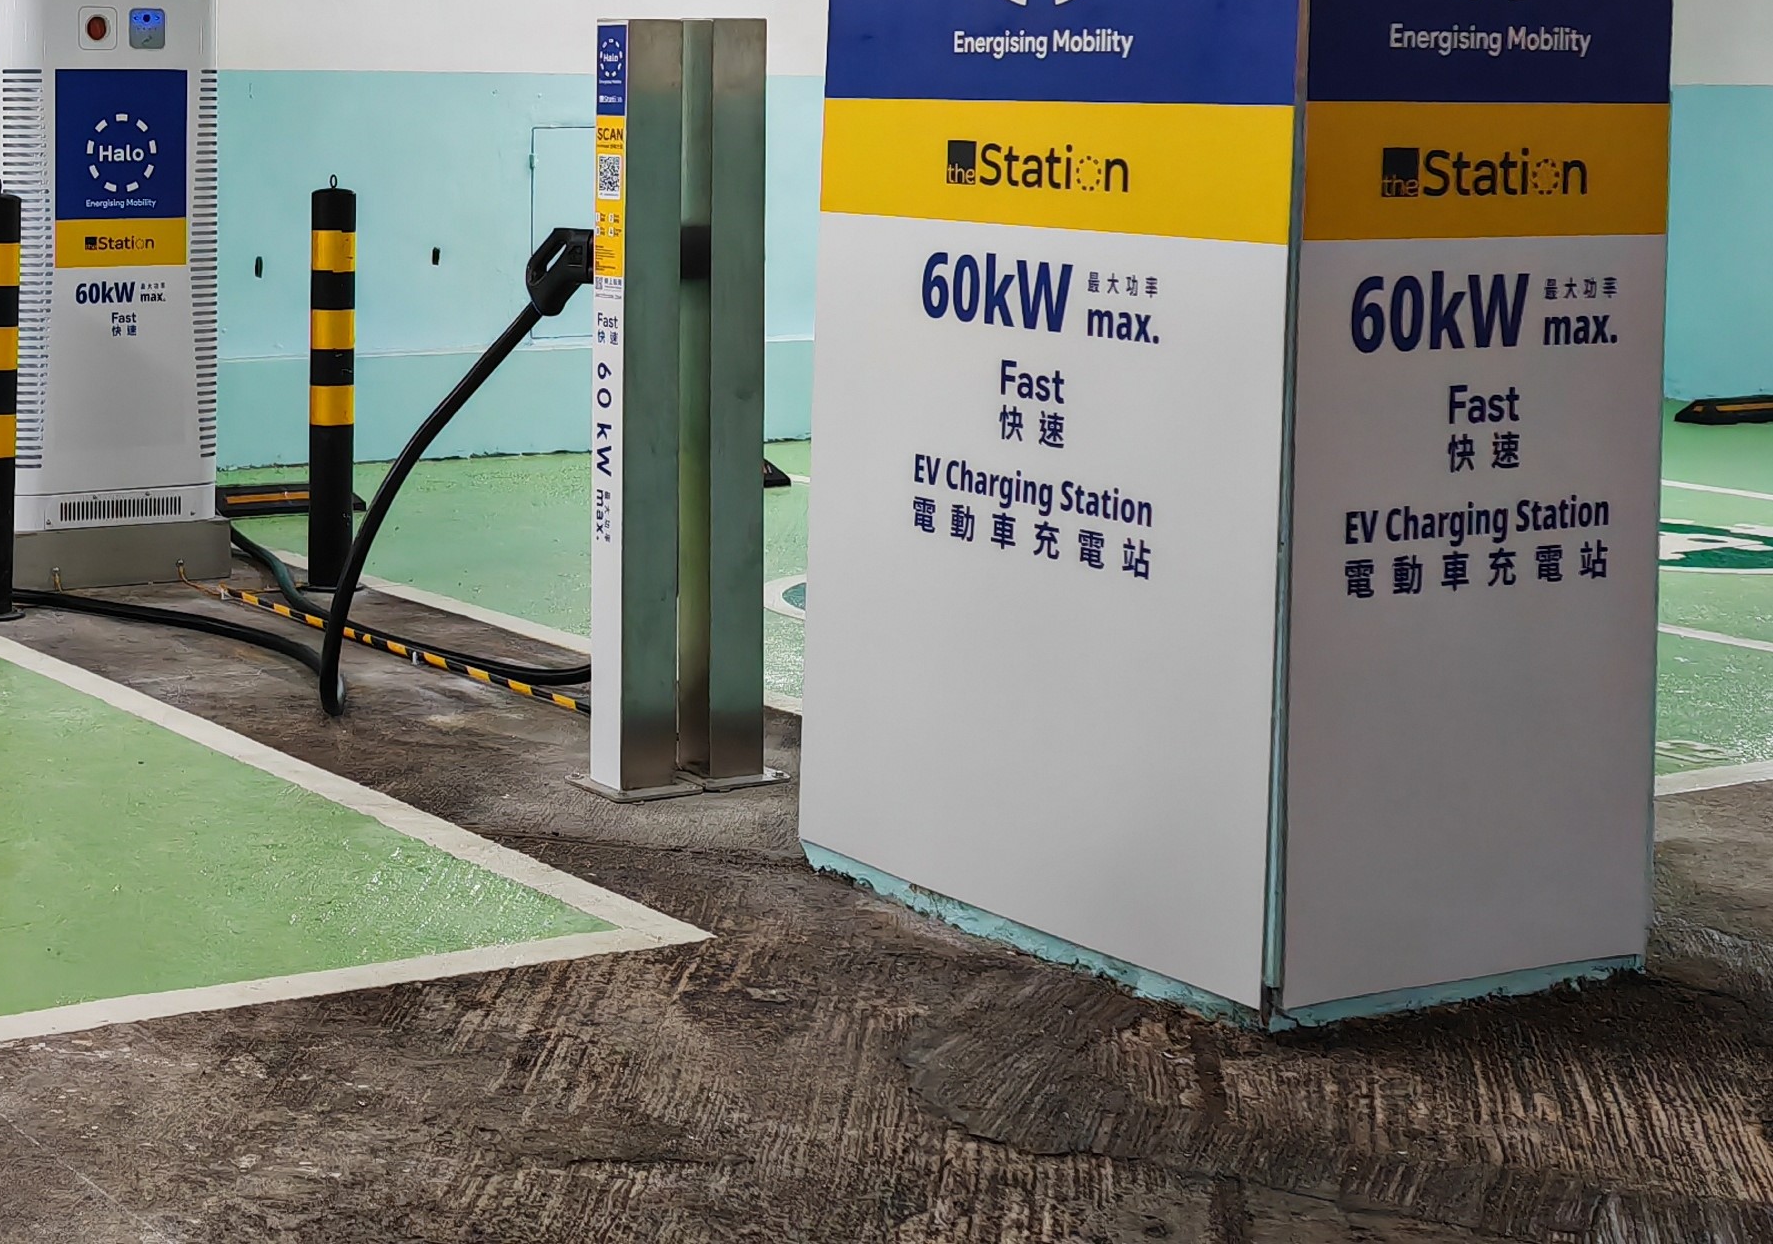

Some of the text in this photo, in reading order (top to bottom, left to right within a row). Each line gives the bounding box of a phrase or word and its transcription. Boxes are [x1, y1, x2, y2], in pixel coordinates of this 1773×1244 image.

[953, 29, 1133, 59] Energising Mobility
[1389, 22, 1591, 57] Energising Mobility
[597, 127, 624, 141] SCAN
[99, 144, 145, 162] Halo
[85, 198, 157, 209] Energising Mobility
[75, 281, 135, 304] 60kW
[140, 292, 166, 302] max.
[921, 251, 1074, 333] 60kW
[1087, 271, 1159, 298] 最大功率
[1544, 276, 1618, 300] 最大功率
[111, 312, 137, 324] Fast
[597, 312, 618, 329] Fast
[1087, 307, 1160, 344] max.
[1351, 270, 1530, 353] 60kW
[111, 325, 137, 337] 快速
[1543, 314, 1618, 345] max.
[1000, 359, 1065, 404] Fast
[1448, 384, 1520, 424] Fast
[999, 405, 1065, 448] 快速
[1447, 431, 1520, 473] 快速
[914, 454, 1153, 528] EV Charging Station
[1345, 495, 1609, 547] EV Charging Station
[912, 496, 1152, 580] 電動車充電站
[1344, 540, 1609, 599] 電動車充電站
